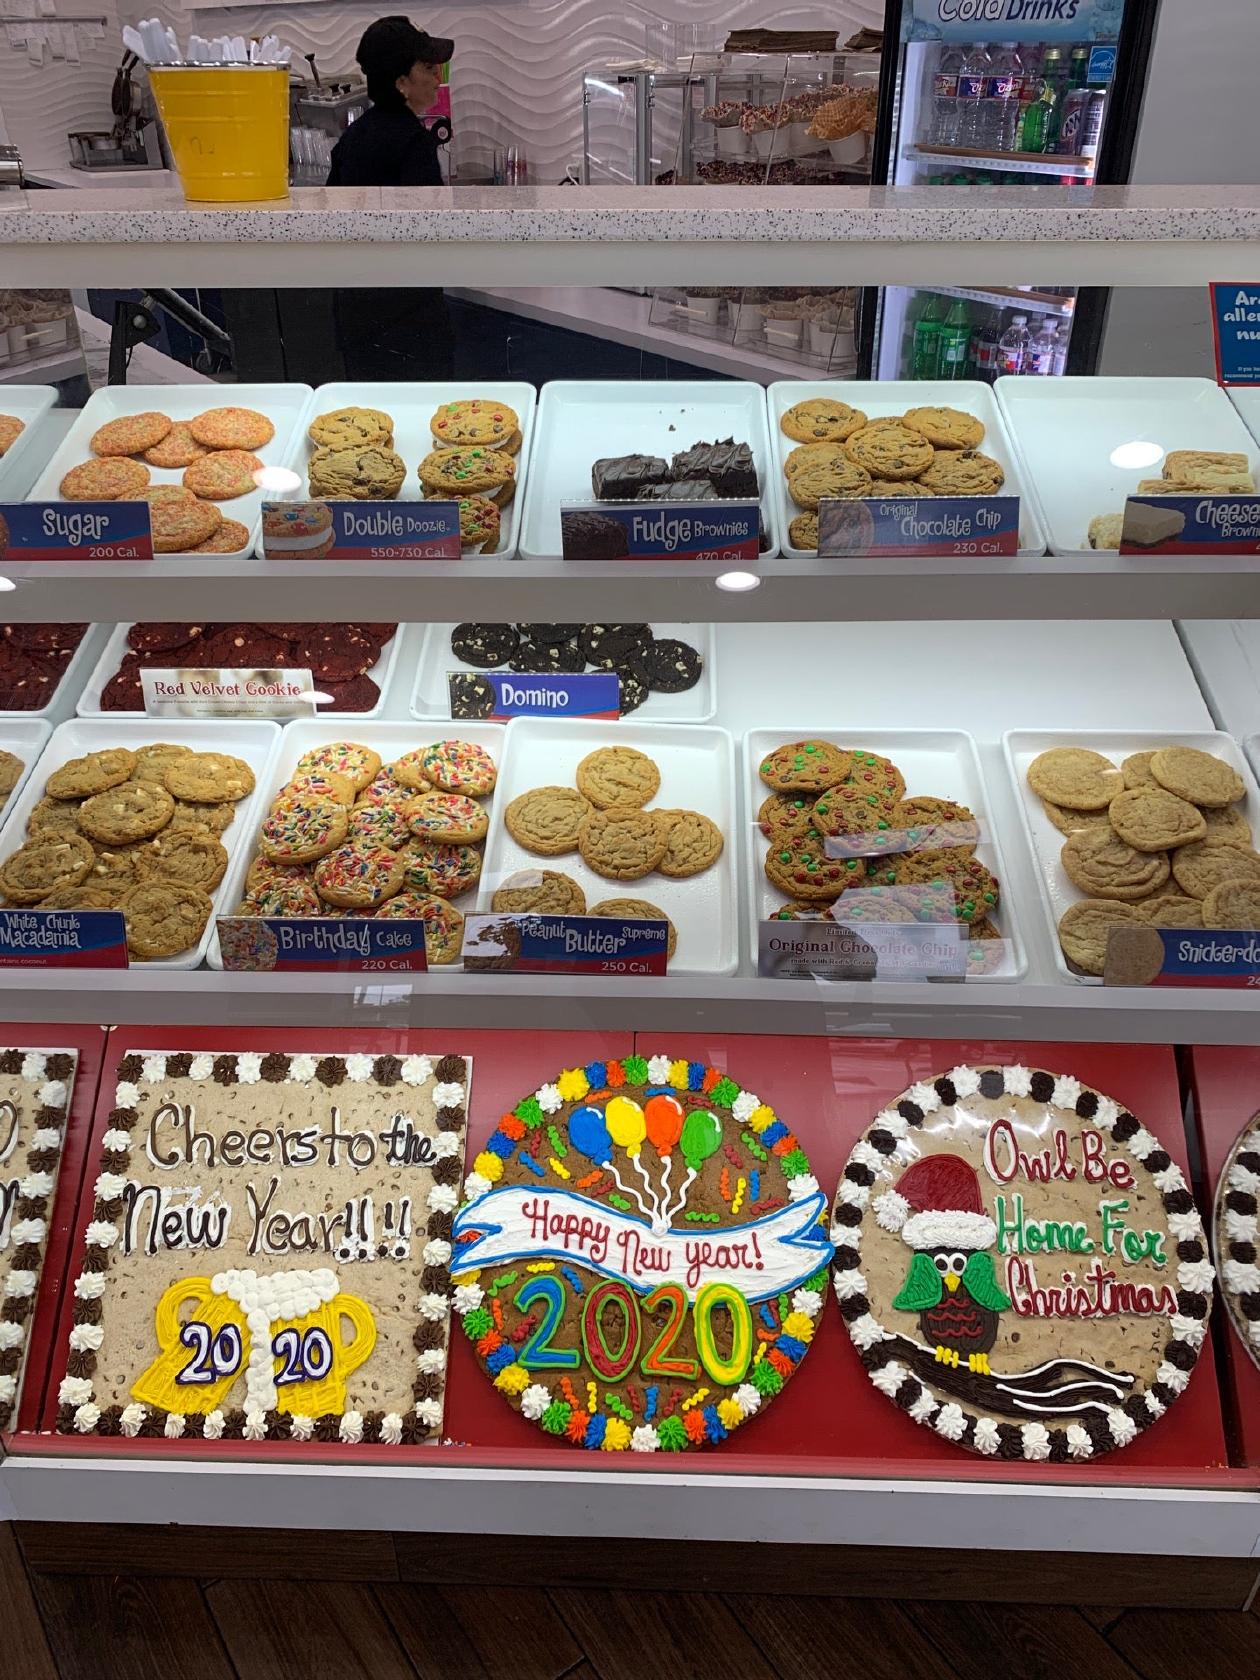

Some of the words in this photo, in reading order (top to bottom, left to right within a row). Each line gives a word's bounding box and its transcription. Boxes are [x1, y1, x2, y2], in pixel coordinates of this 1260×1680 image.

[938, 0, 1004, 22] Cold
[1006, 0, 1080, 20] Drinks
[343, 510, 404, 536] Double
[879, 501, 918, 521] Original
[901, 514, 971, 539] Chocolate
[976, 508, 1002, 530] Chip
[42, 508, 110, 546] Sugar
[632, 511, 692, 550] Fudge
[694, 521, 749, 538] Brownies
[89, 547, 114, 558] 200
[117, 547, 140, 558] Cal.
[371, 547, 421, 558] 550-730
[953, 542, 978, 554] 230
[981, 542, 1004, 554] Cal.
[155, 681, 185, 696] Red
[190, 682, 241, 697] Velvet
[245, 681, 301, 697] Cookie
[501, 683, 569, 709] Domino
[5, 913, 38, 930] White
[46, 914, 81, 930] Chunk
[0, 925, 82, 949] Macadamia
[279, 923, 370, 956] Birthday
[376, 931, 412, 947] Cake
[521, 920, 565, 940] Peanut
[565, 929, 626, 954] Butter
[622, 926, 665, 941] Supreme
[769, 938, 834, 955] Original
[840, 940, 916, 955] Chocolate
[361, 960, 386, 970] 220
[389, 960, 413, 970] Cal.
[601, 961, 626, 972] 250
[629, 961, 652, 973] Cal.
[379, 1112, 438, 1165] the
[983, 1118, 1076, 1186] Owl
[1081, 1129, 1137, 1190] Be
[121, 1179, 231, 1256] New
[995, 1193, 1097, 1255] Home
[1101, 1199, 1169, 1267] For
[522, 1198, 609, 1263] Happy
[617, 1230, 670, 1275] New
[1004, 1255, 1179, 1319] Christmas
[513, 1275, 752, 1386] 2020
